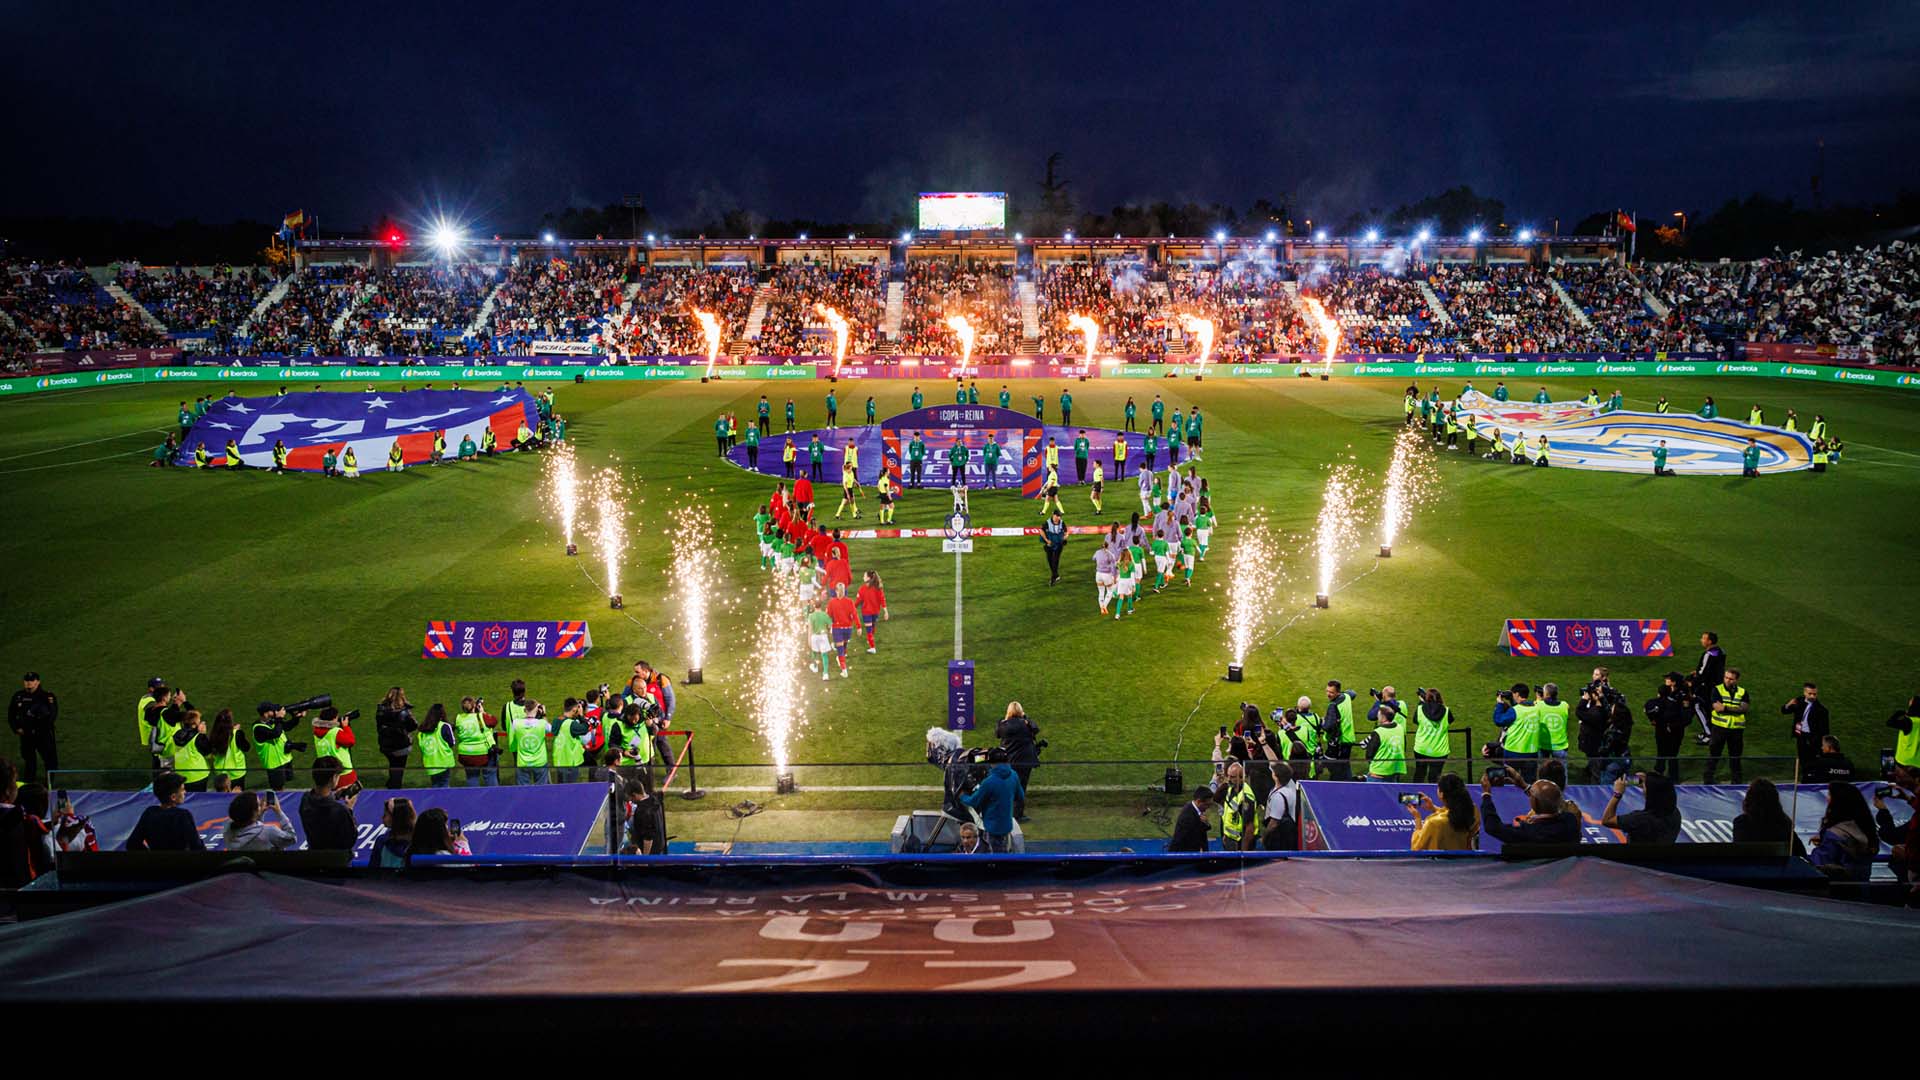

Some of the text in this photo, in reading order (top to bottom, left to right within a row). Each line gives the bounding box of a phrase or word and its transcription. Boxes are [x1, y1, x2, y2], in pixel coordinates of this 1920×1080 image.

[596, 369, 624, 377] Iberdrola
[1608, 365, 1636, 373] Iberdrola
[1792, 367, 1817, 376] Iberdrola
[107, 372, 133, 380] Iberdrola
[1847, 371, 1875, 381] Iberdrola
[50, 377, 78, 386] Iberdrola
[464, 627, 475, 640] 22
[513, 629, 528, 638] COPA
[536, 627, 547, 640] 22
[1546, 625, 1558, 638] 22
[1595, 627, 1611, 637] COPA
[1619, 625, 1631, 638] 22
[462, 643, 473, 655] 23
[534, 643, 545, 655] 23
[1549, 641, 1560, 653] 23
[1622, 641, 1633, 653] 23
[490, 821, 565, 830] IBERDROLA
[589, 896, 757, 905] REINA
[781, 892, 847, 903] LA
[1003, 892, 1074, 900] DE
